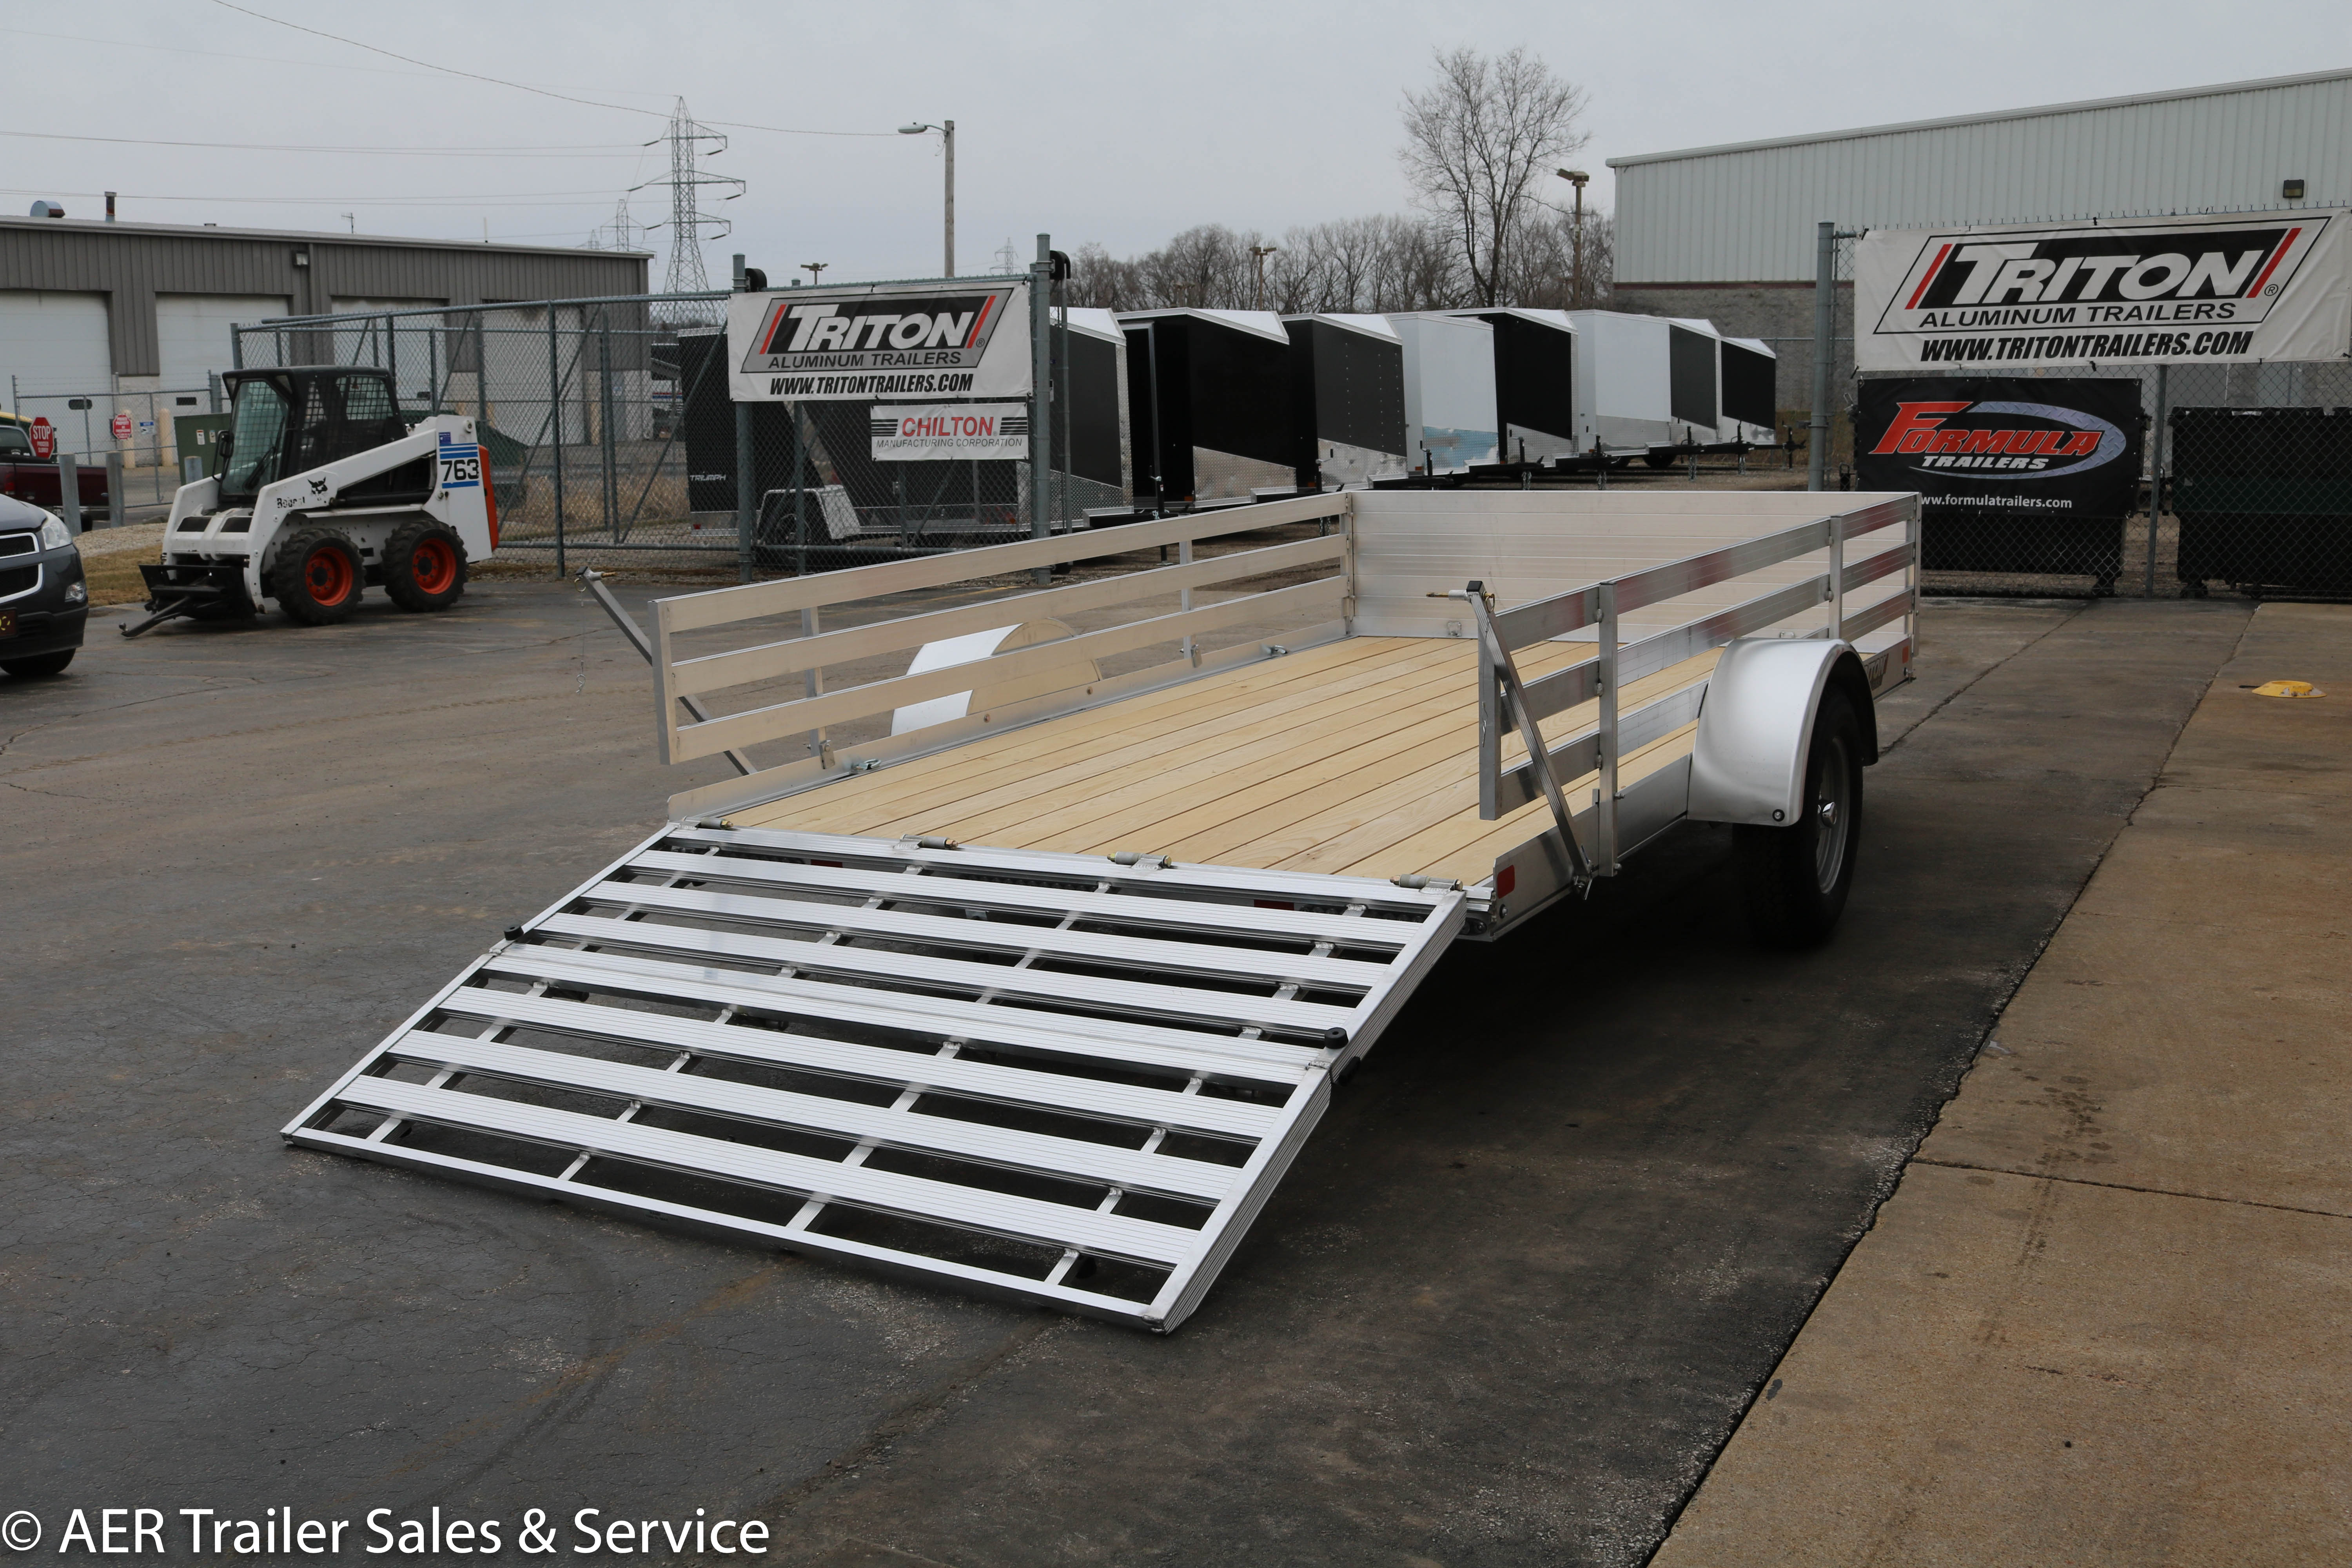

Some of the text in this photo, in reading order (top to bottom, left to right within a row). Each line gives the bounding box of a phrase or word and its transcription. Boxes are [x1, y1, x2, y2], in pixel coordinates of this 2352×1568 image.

[1952, 242, 2265, 305] TRITON
[1919, 302, 2236, 328] ALUMINUM TRAILERS
[787, 304, 975, 352] TRITON
[1920, 330, 2255, 362] WWW.TRITONTRAILERS.COM
[768, 351, 962, 368] ALUMINUM TRAILERS
[769, 373, 974, 395] WWW.TRITONTRAILERS.COM
[33, 425, 51, 440] STOP
[902, 416, 994, 437] CHILTON
[1868, 401, 2103, 456] FORMULA
[876, 438, 1022, 448] MANUFACTURING CORPORATION
[440, 459, 479, 481] 763
[1922, 455, 2049, 469] TRAILERS
[1921, 494, 2073, 508] ww.formulatrailers.com
